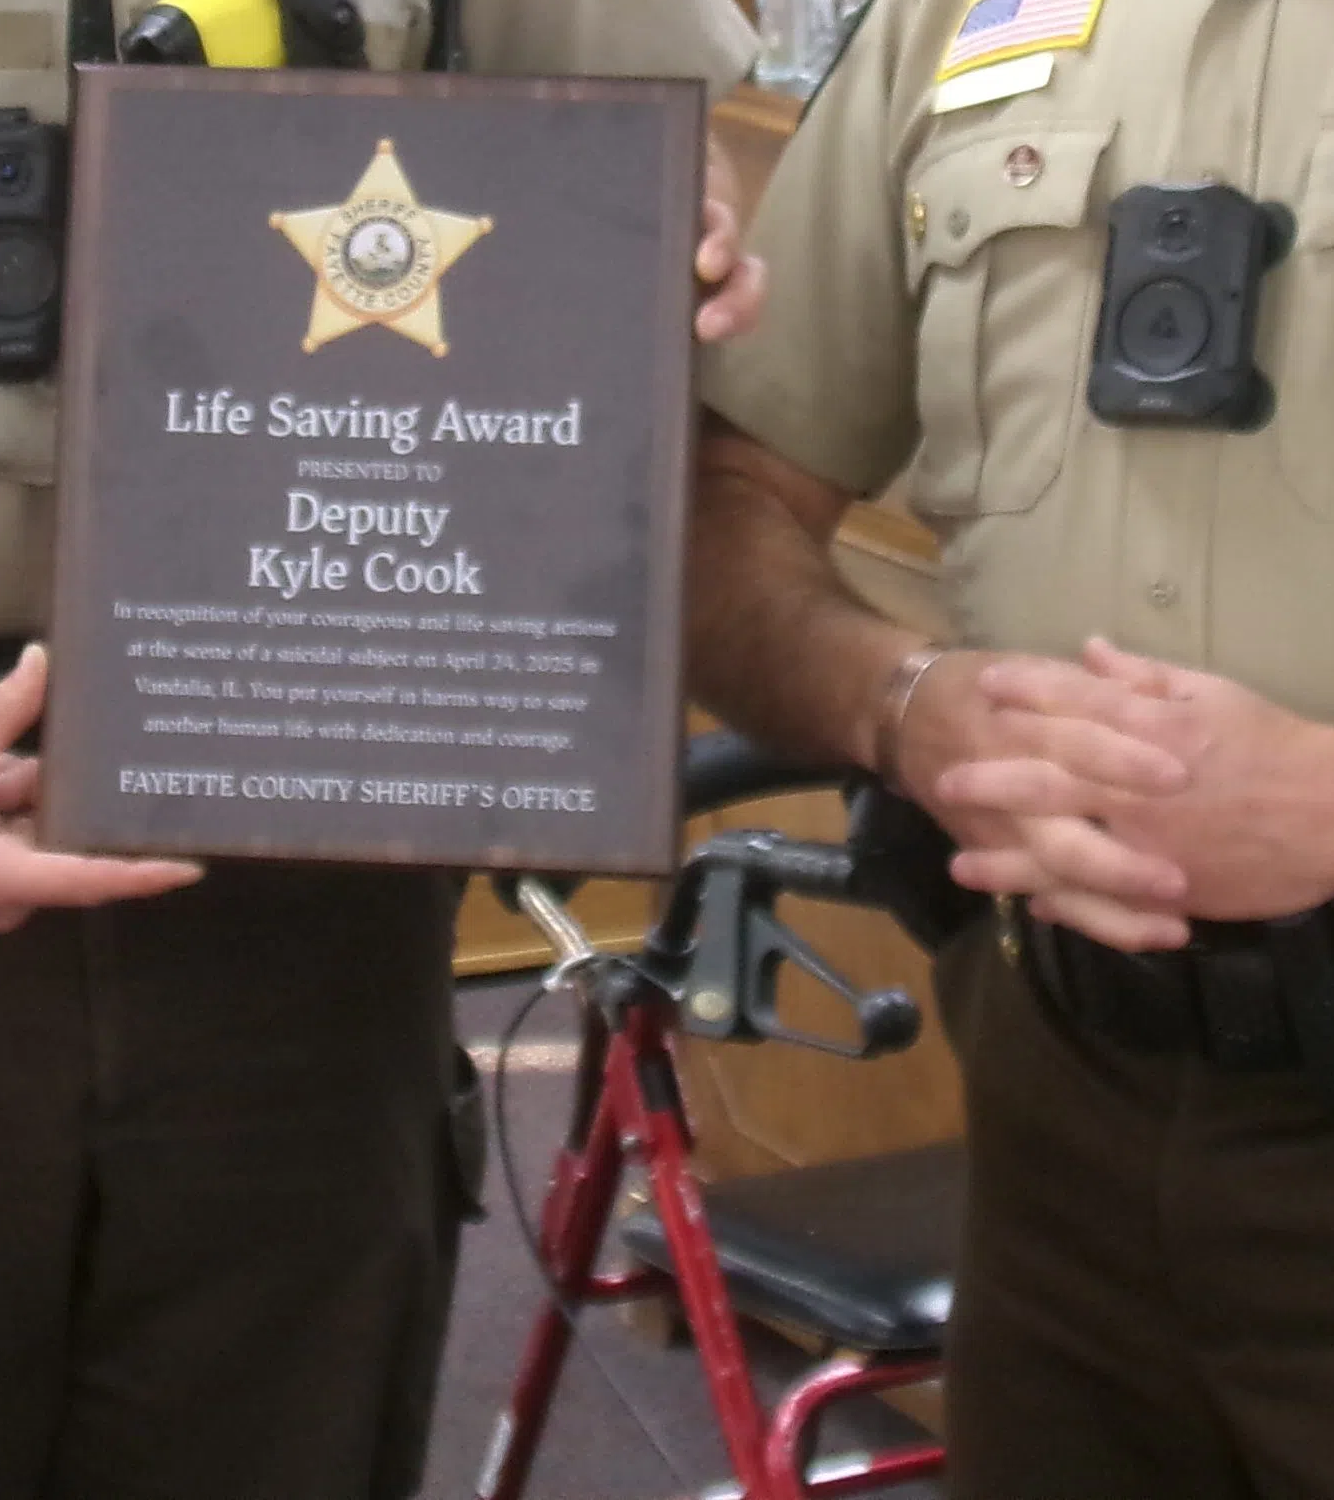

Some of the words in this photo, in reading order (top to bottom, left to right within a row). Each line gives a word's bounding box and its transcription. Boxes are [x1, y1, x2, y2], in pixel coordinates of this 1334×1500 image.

[341, 198, 418, 221] SHERIFF
[326, 232, 376, 308] FAYETTE
[384, 238, 433, 307] COUNTY
[166, 390, 255, 436] Life
[267, 396, 422, 455] Saving
[431, 400, 583, 446] Award
[297, 458, 408, 481] PRESENTED
[415, 462, 444, 483] TO
[285, 491, 451, 548] Deputy
[247, 547, 350, 599] Kyle
[366, 550, 484, 596] Cook
[113, 601, 131, 619] In
[137, 604, 238, 626] recognition
[243, 606, 264, 624] of
[267, 611, 308, 629] your
[418, 614, 451, 631] and
[127, 642, 142, 657] at
[149, 639, 177, 658] the
[183, 645, 232, 660] scene
[237, 643, 258, 661] of
[414, 654, 437, 668] on
[444, 651, 485, 674] April
[249, 681, 283, 699] You
[287, 685, 317, 705] put
[460, 727, 494, 746] and
[119, 770, 236, 799] FAYETTE
[241, 775, 354, 802] COUNTY
[360, 780, 495, 809] SHERIFF'S
[501, 785, 596, 813] OFFICE
